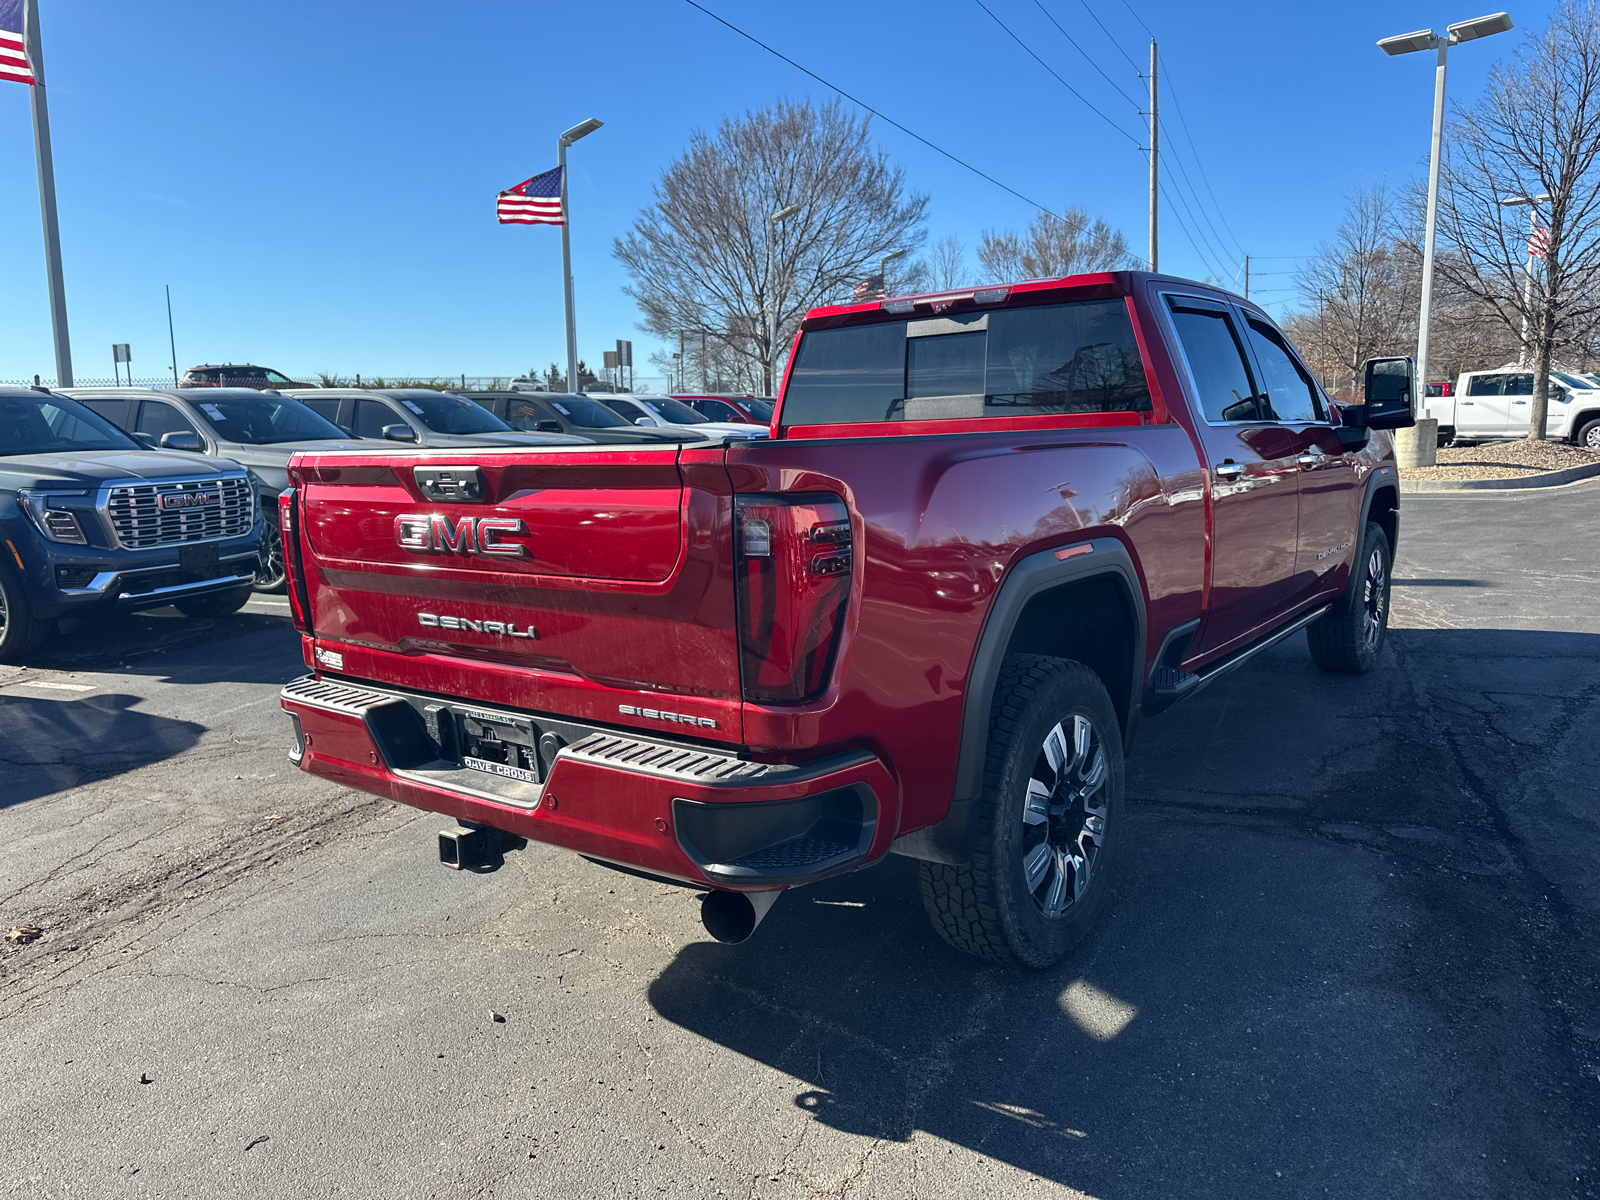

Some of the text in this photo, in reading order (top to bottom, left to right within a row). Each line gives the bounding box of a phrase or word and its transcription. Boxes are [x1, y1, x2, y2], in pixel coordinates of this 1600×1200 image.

[164, 491, 221, 508] GMC
[394, 513, 526, 558] GMC
[417, 612, 537, 640] DENALI
[618, 704, 717, 729] SIERRA
[464, 758, 533, 782] DAVE CROSS
